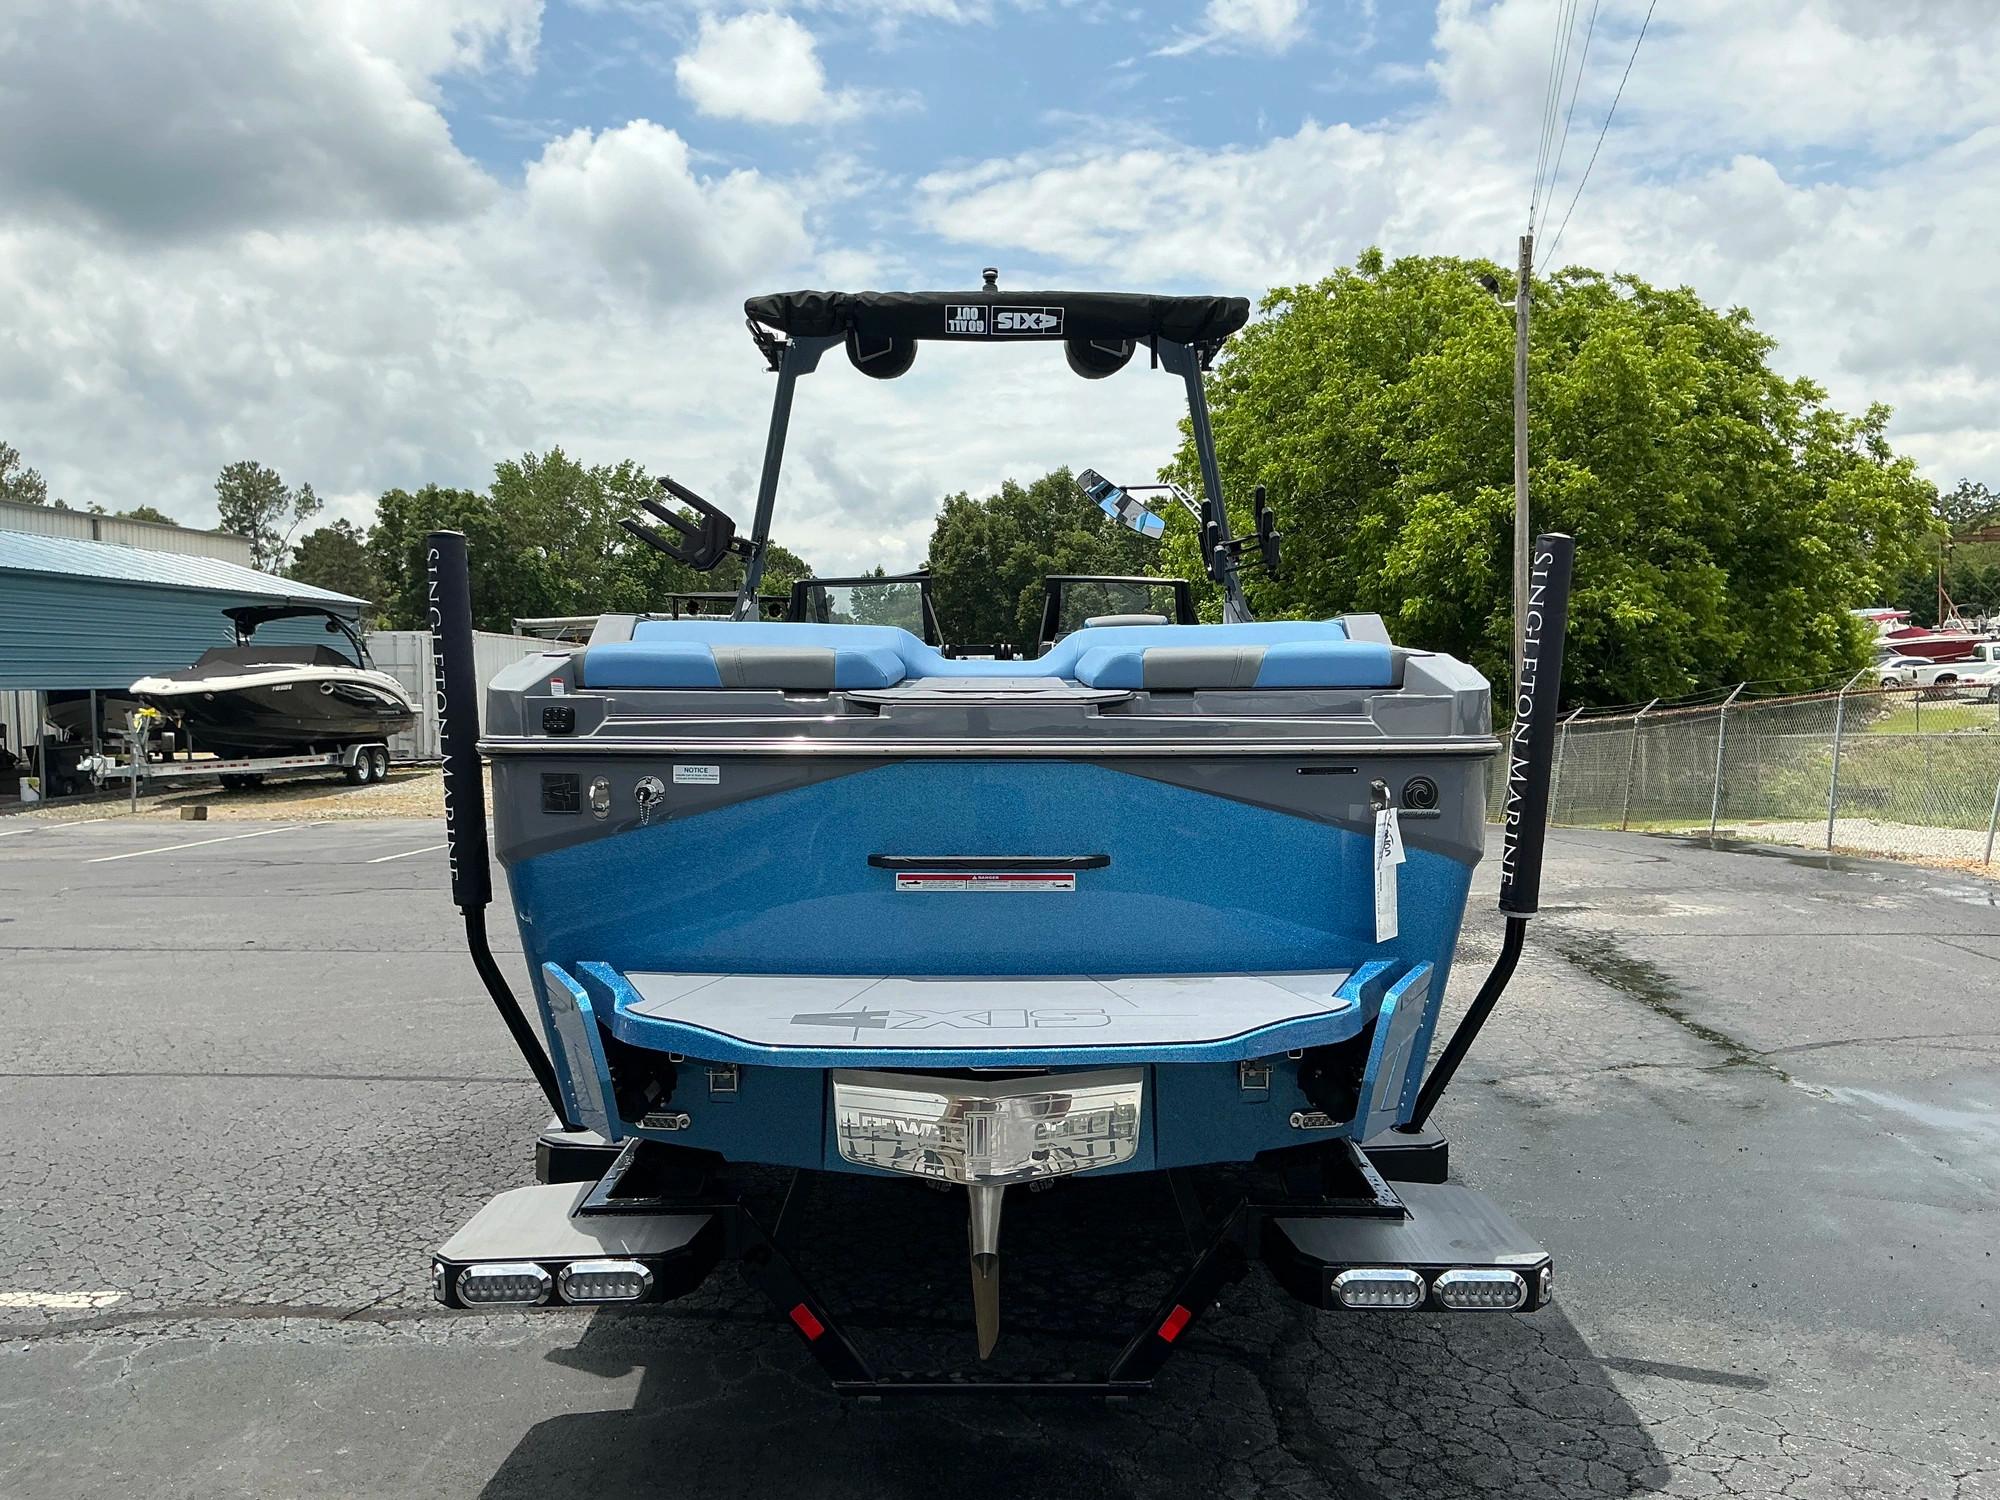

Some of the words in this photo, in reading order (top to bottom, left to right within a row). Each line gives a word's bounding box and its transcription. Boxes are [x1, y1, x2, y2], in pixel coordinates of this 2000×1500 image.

[956, 308, 979, 320] OUT
[998, 313, 1058, 329] AXIS
[949, 320, 968, 331] ALL
[968, 320, 985, 332] GO
[1512, 551, 1553, 745] SINGLETON
[1501, 756, 1530, 886] MARINE
